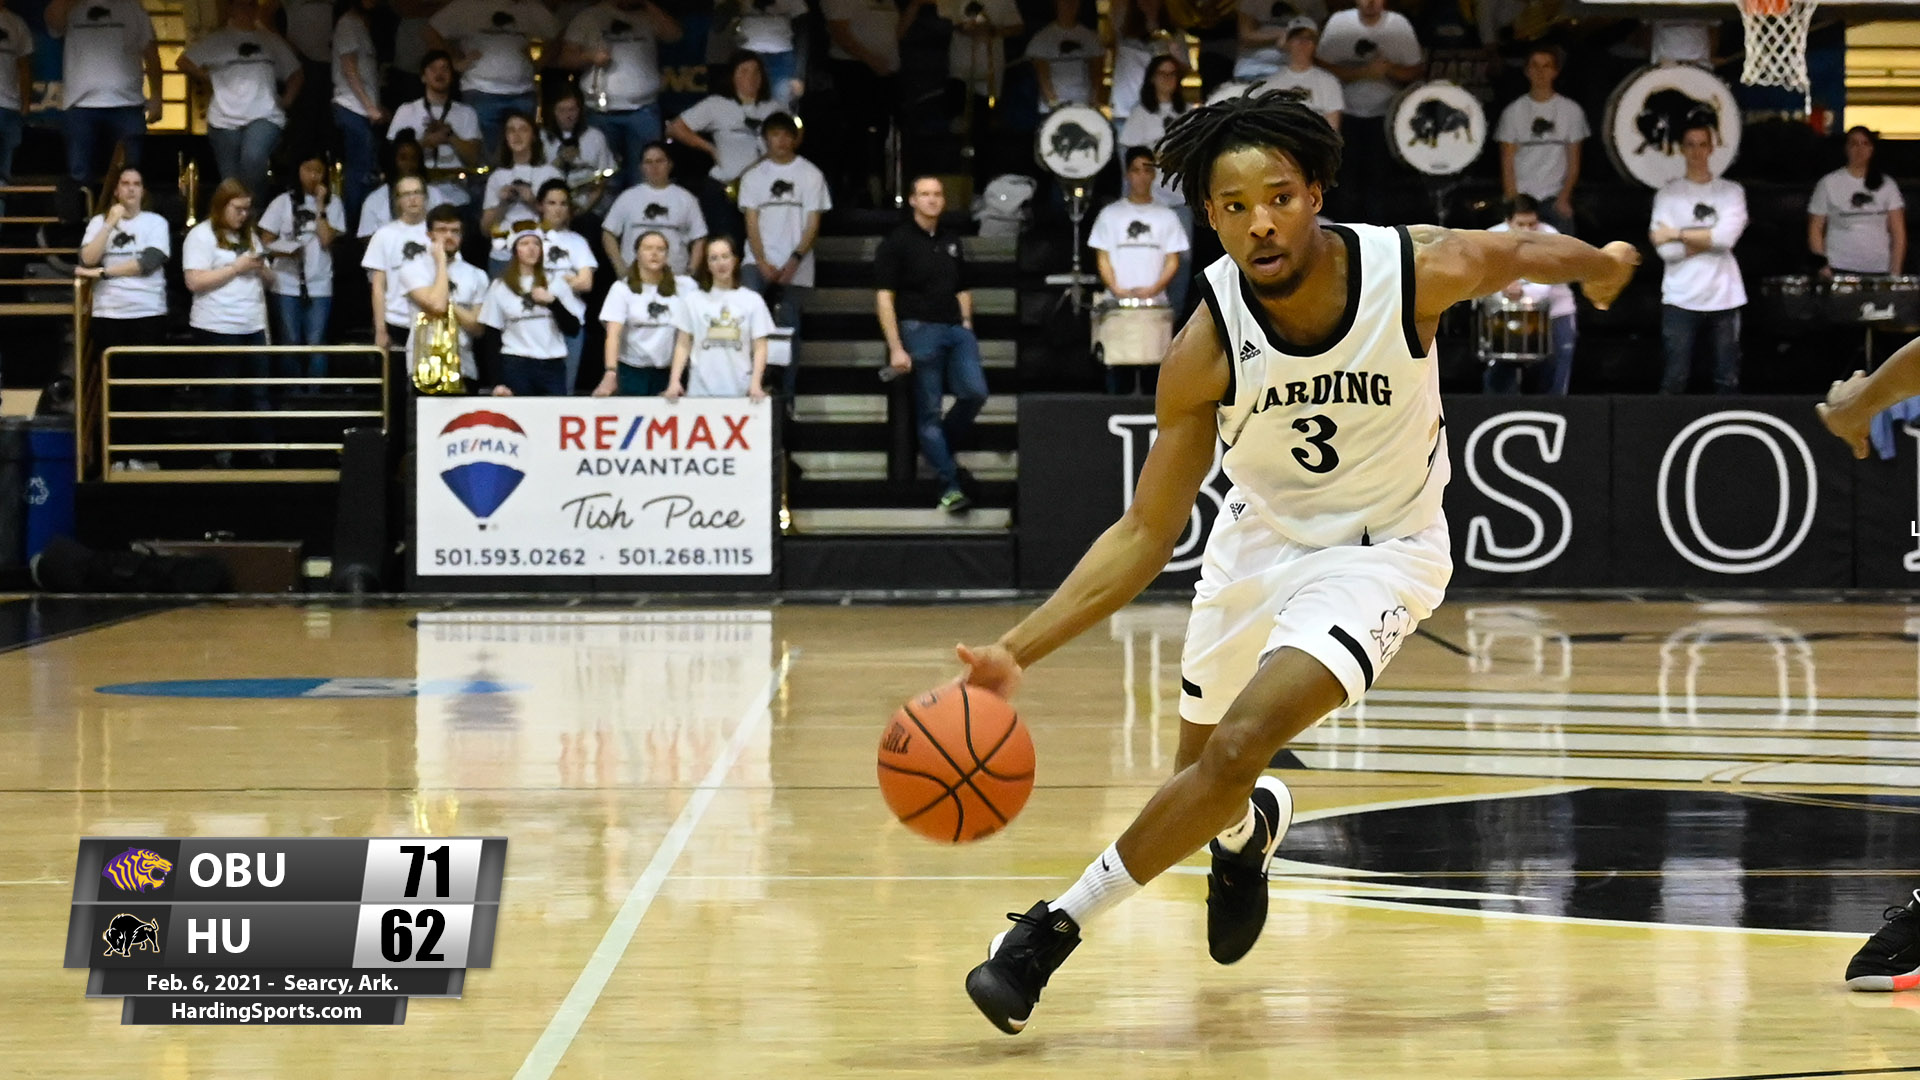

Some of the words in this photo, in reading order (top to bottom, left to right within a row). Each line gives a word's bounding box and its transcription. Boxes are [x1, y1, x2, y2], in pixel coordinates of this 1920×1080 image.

[559, 415, 750, 450] RE/MAX
[1291, 414, 1340, 474] 3
[447, 438, 519, 457] RE/MAX
[576, 457, 736, 476] ADVANTAGE
[561, 492, 634, 529] Tish
[642, 495, 746, 529] Pace
[435, 548, 586, 566] 501.593.0262
[619, 548, 753, 566] 501.268.1115
